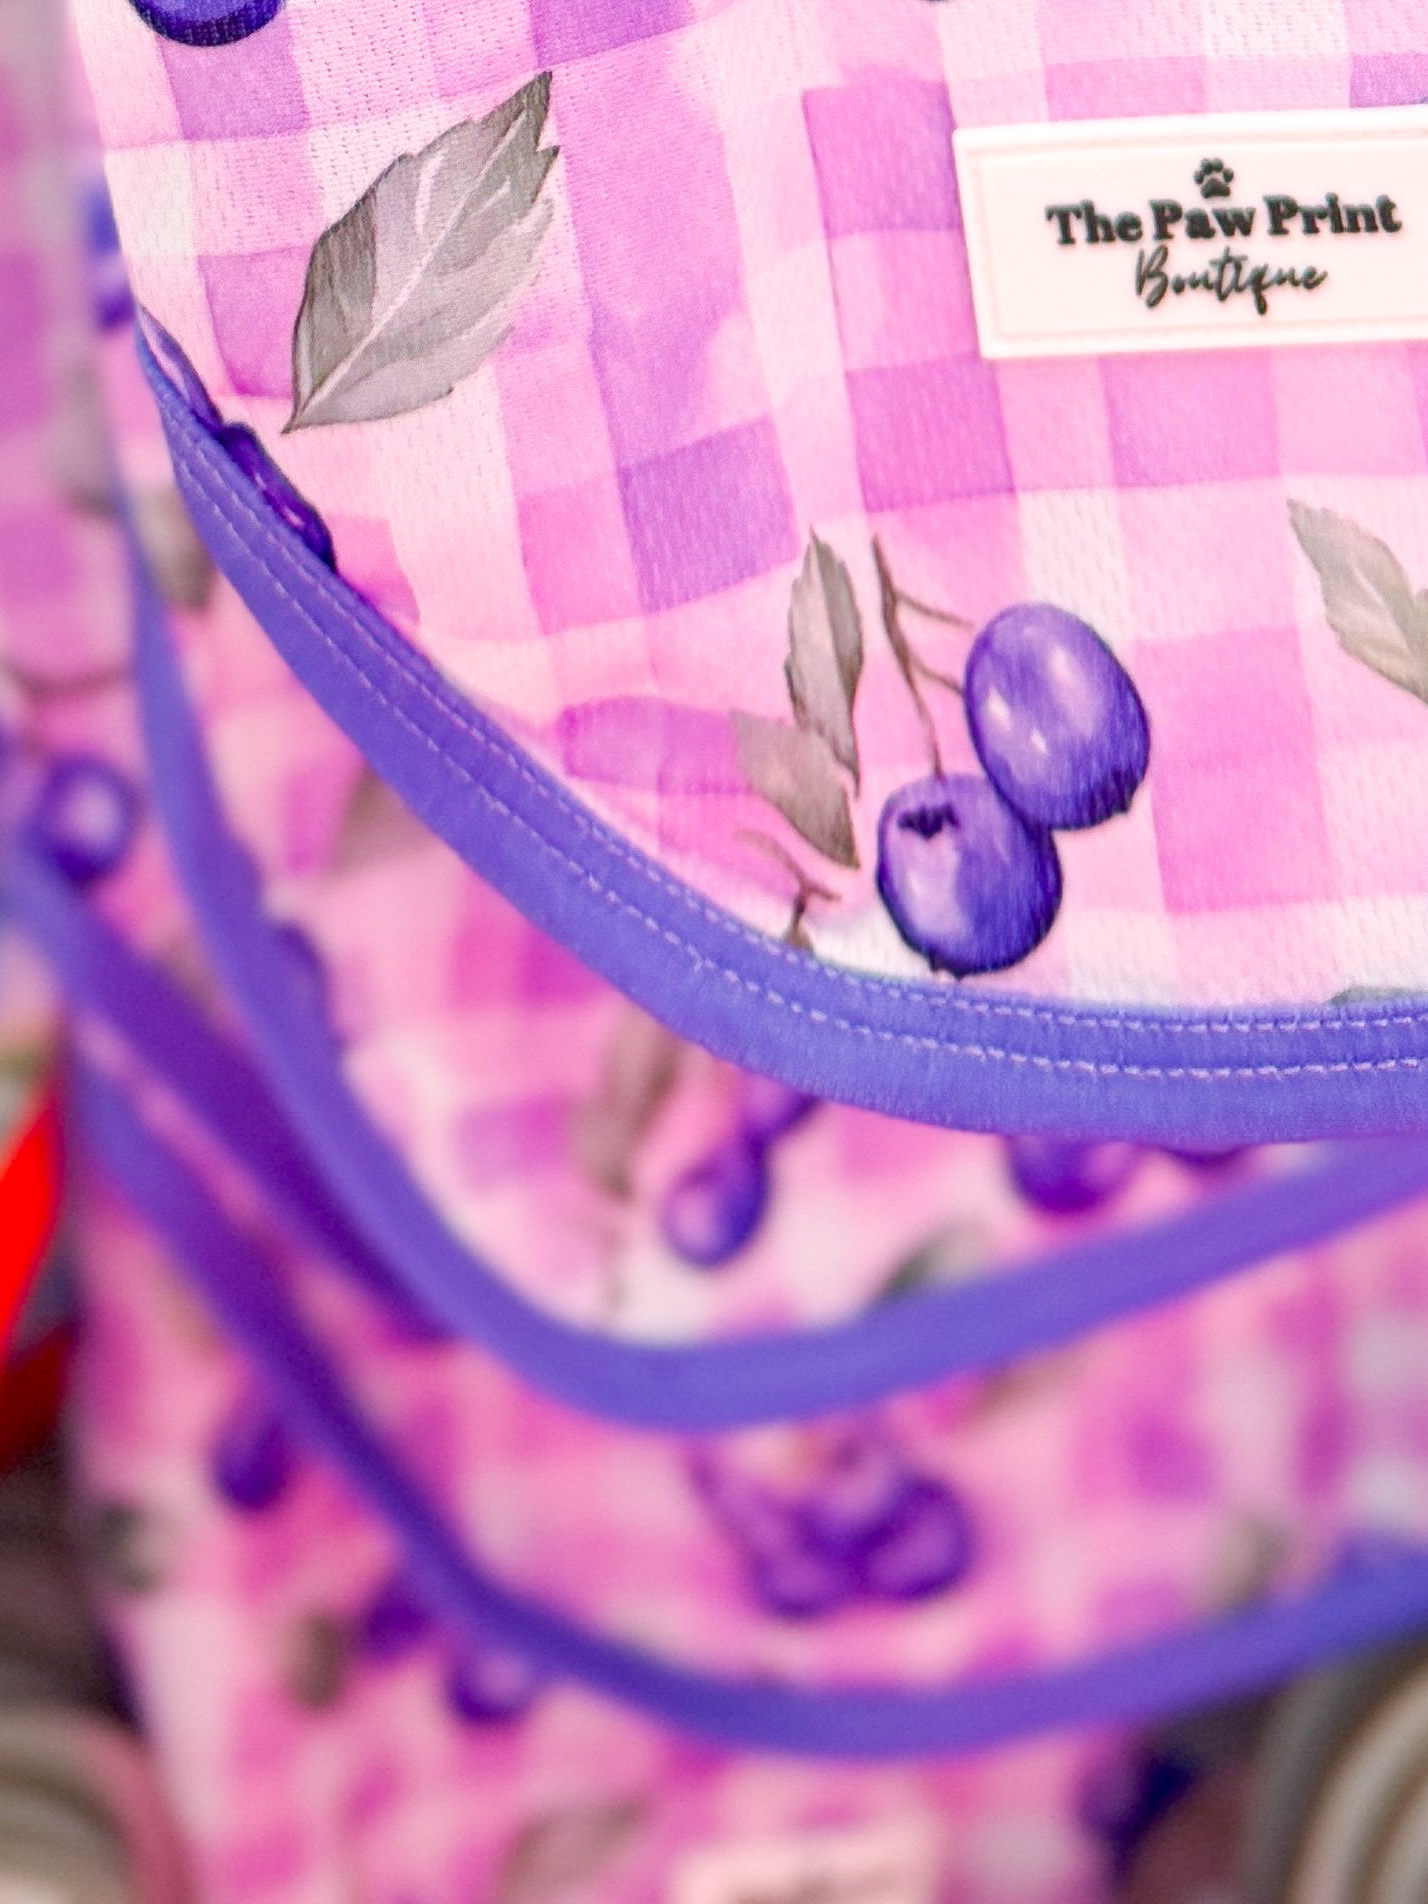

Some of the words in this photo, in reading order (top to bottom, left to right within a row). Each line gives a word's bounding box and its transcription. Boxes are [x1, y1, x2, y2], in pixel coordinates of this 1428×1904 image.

[1045, 201, 1143, 245] The
[1149, 198, 1256, 240] Paw
[1264, 193, 1403, 236] Print
[1136, 245, 1328, 315] Boutique
